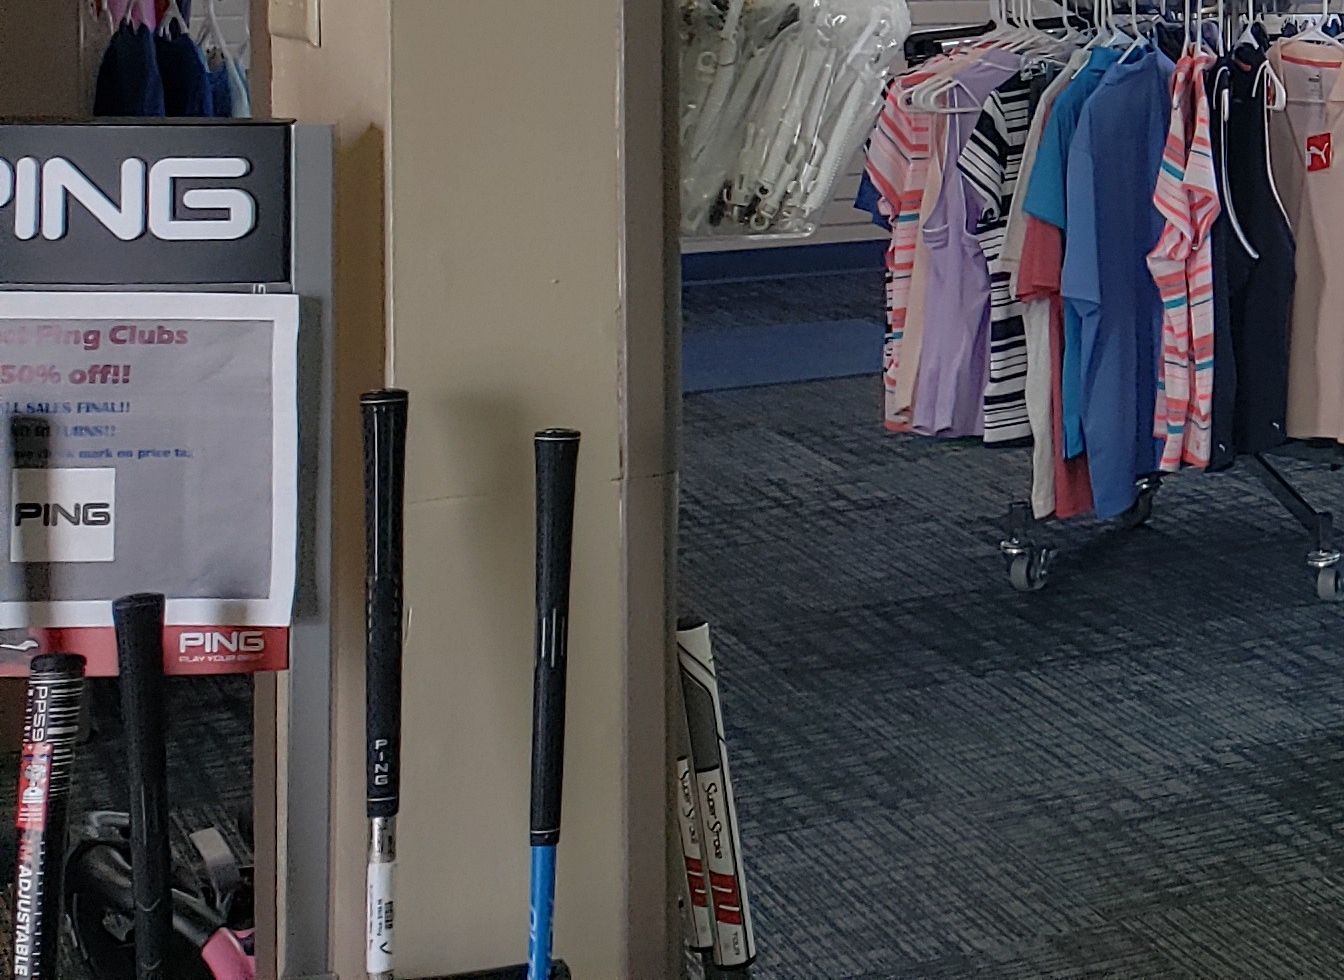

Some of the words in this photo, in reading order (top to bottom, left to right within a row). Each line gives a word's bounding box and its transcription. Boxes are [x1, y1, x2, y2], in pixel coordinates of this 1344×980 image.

[0, 156, 257, 241] ING
[109, 325, 189, 345] Clubs
[68, 365, 132, 384] off!!
[15, 503, 110, 527] PING
[179, 631, 264, 653] PING
[375, 739, 389, 786] PING
[13, 864, 32, 977] ADJUSTABLE
